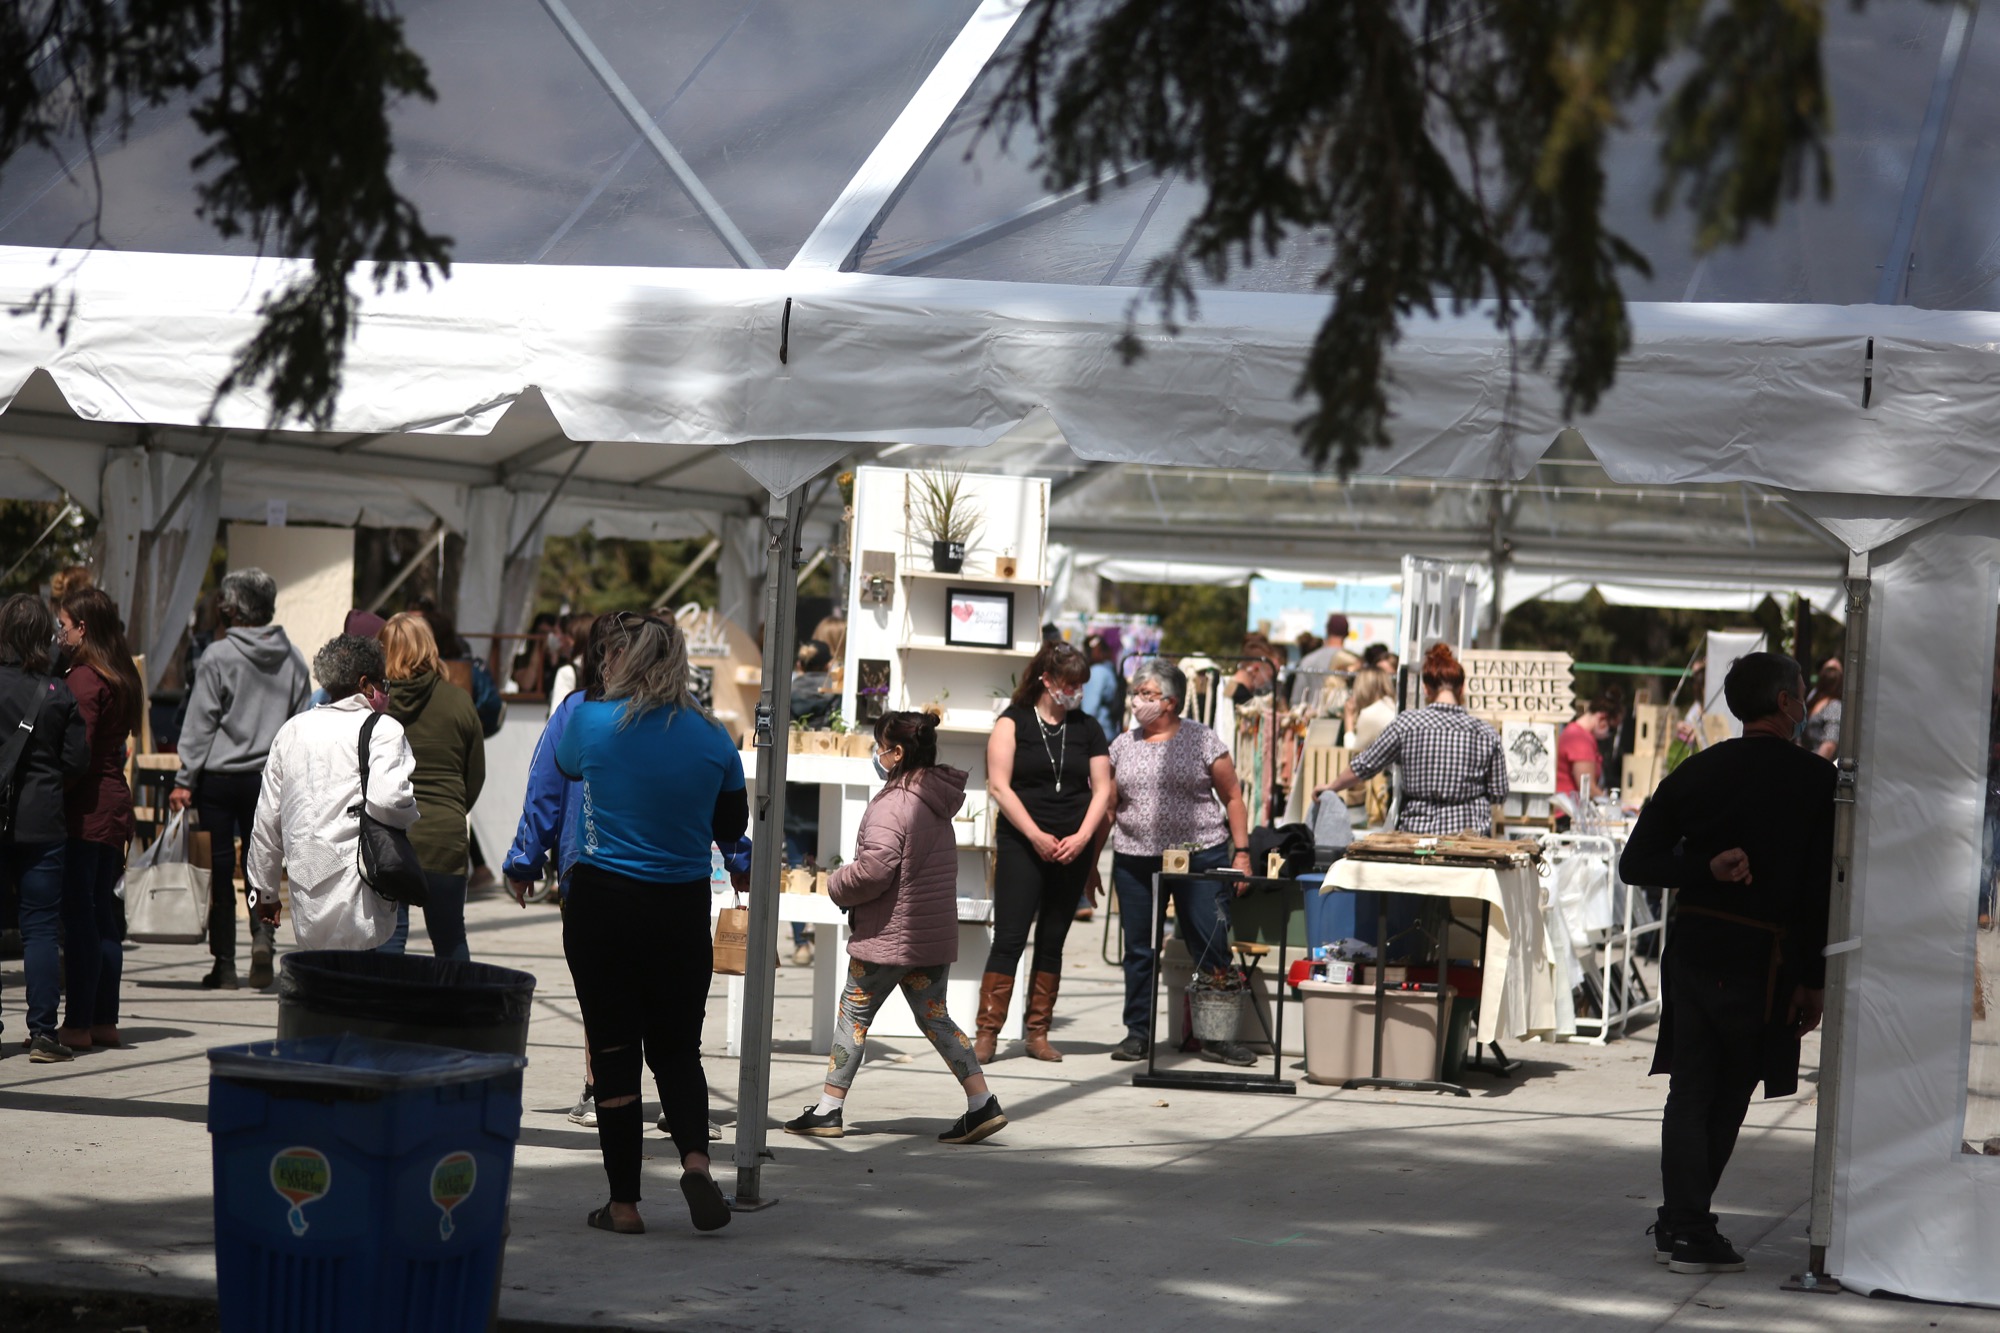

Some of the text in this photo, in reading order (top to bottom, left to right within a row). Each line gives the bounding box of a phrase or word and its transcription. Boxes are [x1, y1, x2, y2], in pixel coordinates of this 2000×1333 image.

[1473, 660, 1555, 676] HANNAH
[1468, 678, 1563, 694] GUTHRIE
[1468, 696, 1564, 712] DESIGNS
[280, 1168, 316, 1181] EVERY
[437, 1175, 465, 1188] EVERY
[287, 1179, 324, 1194] WHERE
